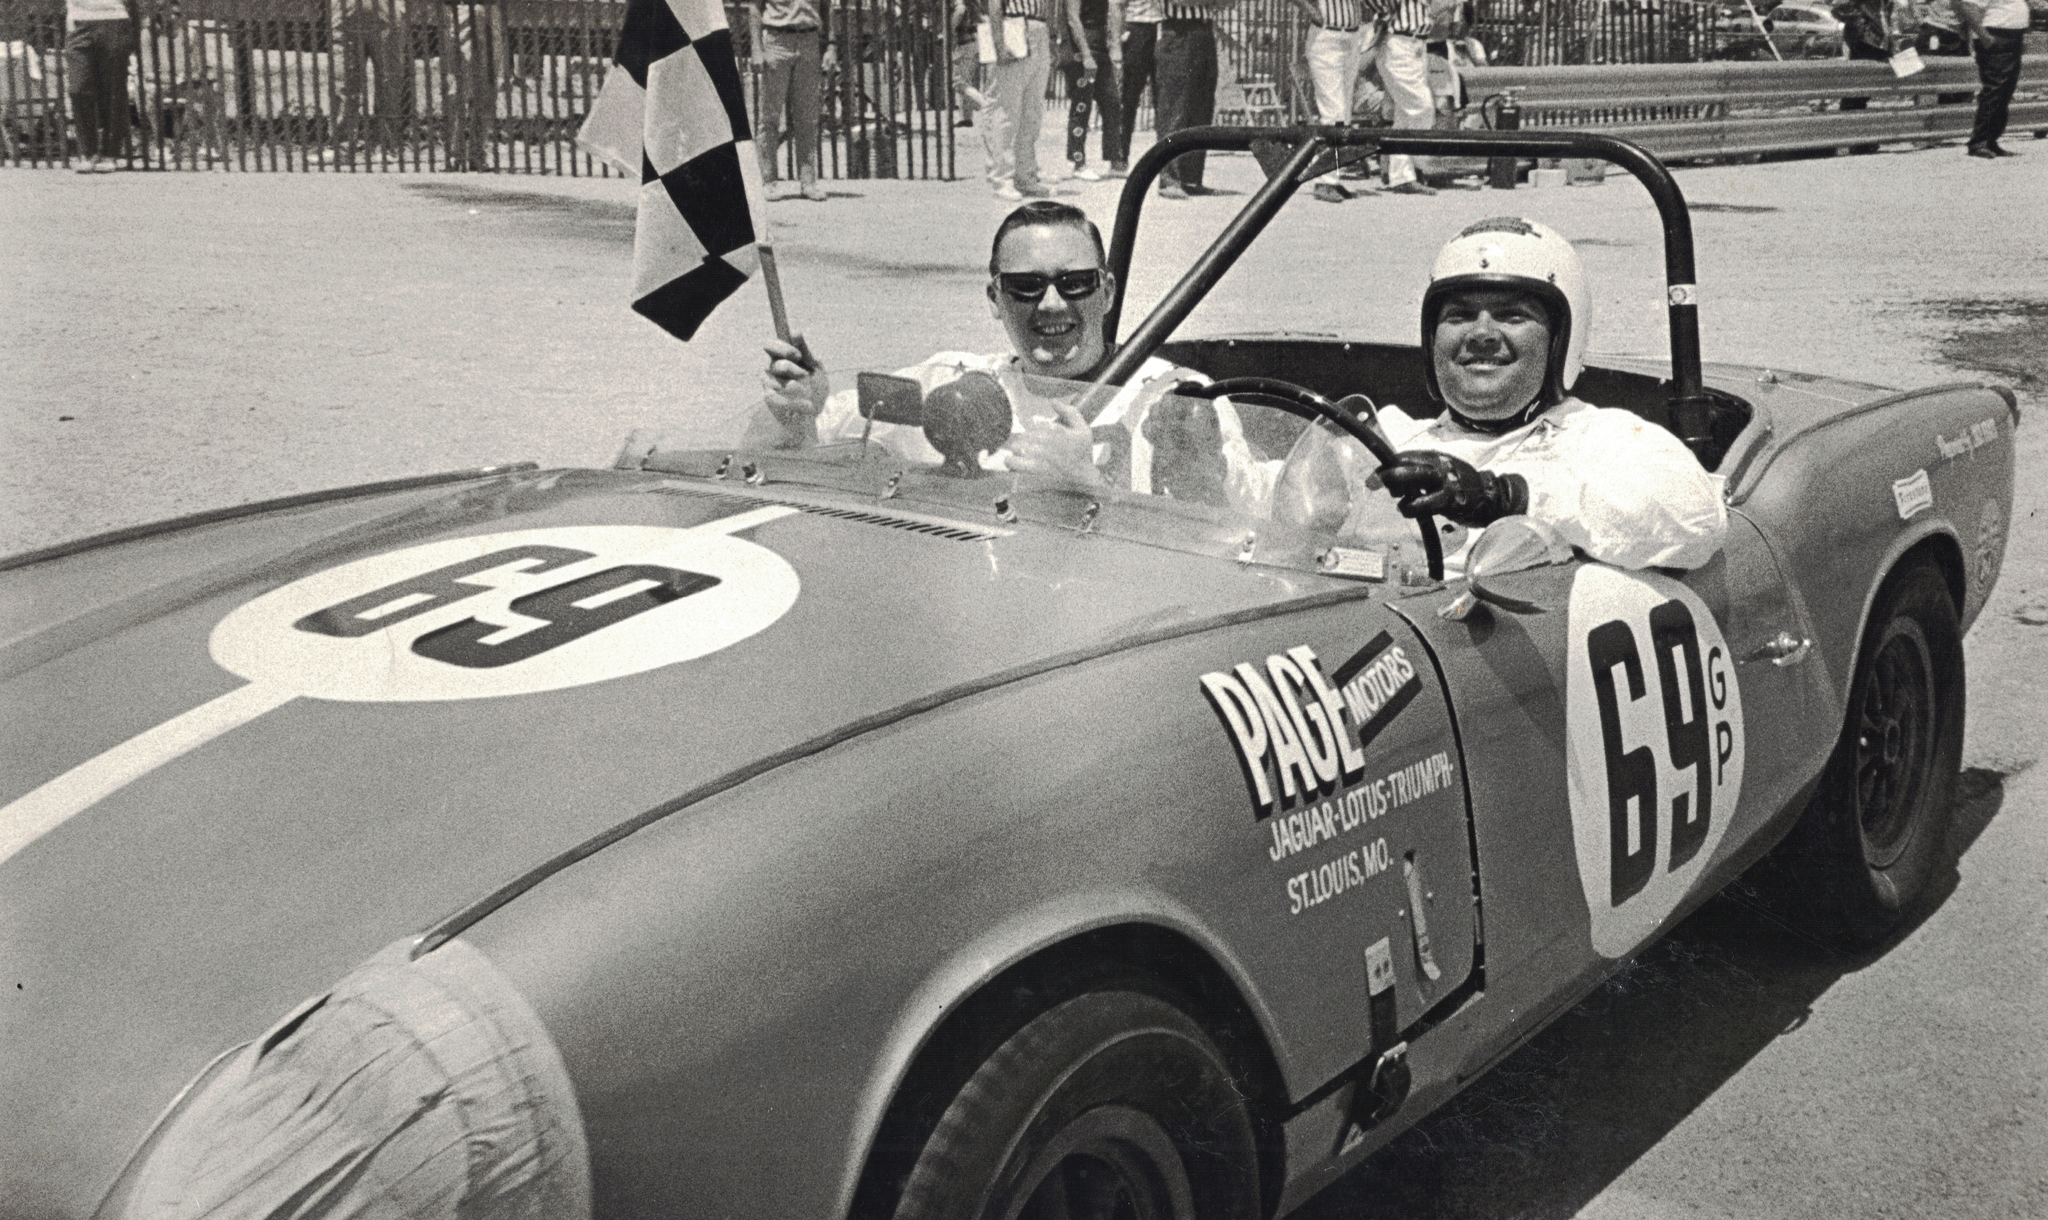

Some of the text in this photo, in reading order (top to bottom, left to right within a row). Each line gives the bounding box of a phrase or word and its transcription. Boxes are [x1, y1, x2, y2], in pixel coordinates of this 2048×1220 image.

[293, 545, 722, 669] 69
[1200, 645, 1414, 814] PAGE MOTORS
[1588, 600, 1713, 908] 69
